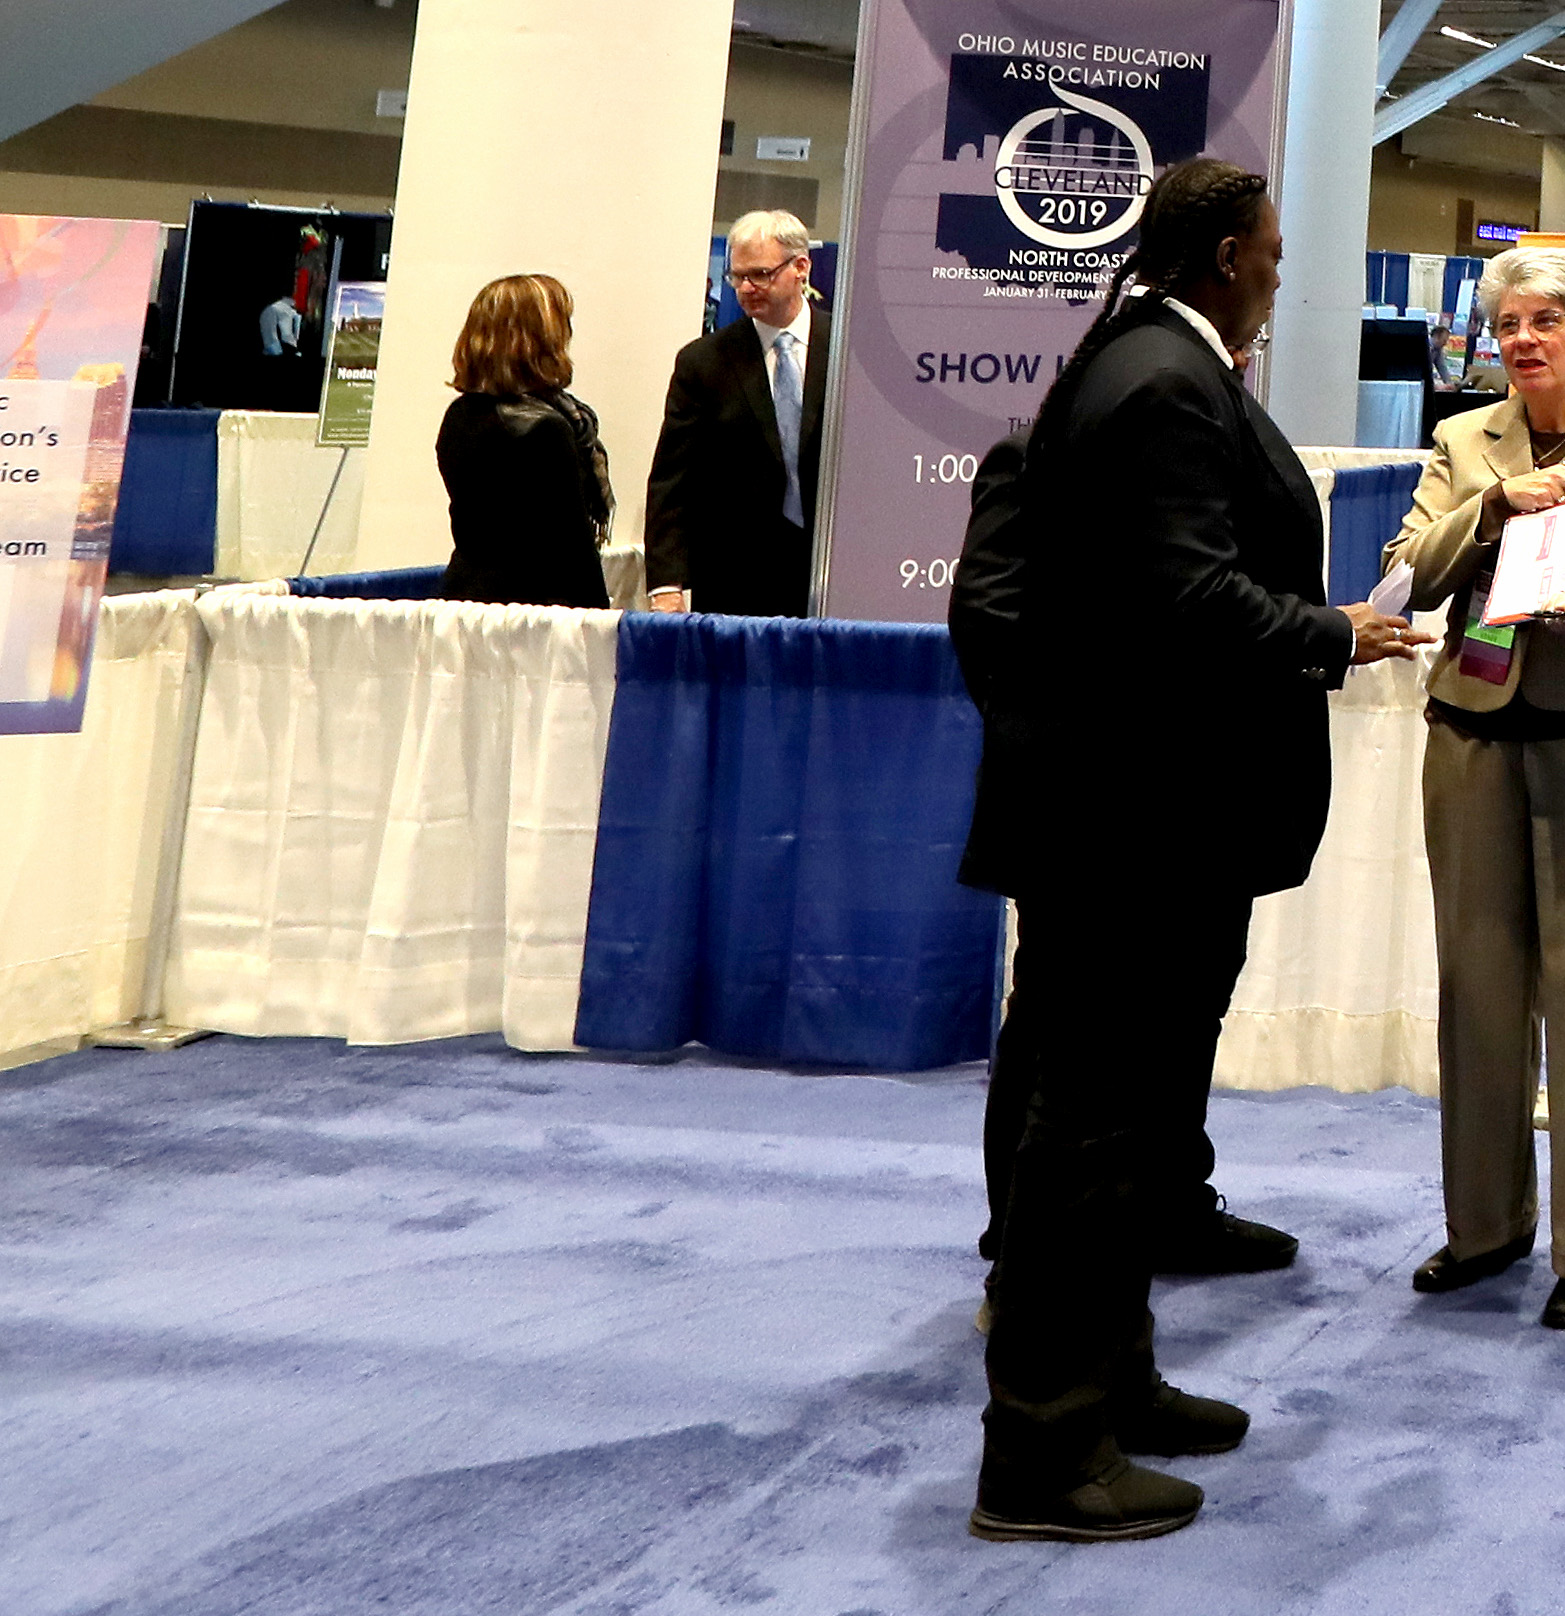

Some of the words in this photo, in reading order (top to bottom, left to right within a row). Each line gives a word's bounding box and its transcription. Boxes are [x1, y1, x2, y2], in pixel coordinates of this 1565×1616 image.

[958, 33, 1015, 54] OHIO
[1022, 39, 1086, 60] MUSIC
[1092, 45, 1205, 70] EDUCATION
[1003, 62, 1160, 90] ASSOCIATION
[994, 167, 1154, 196] CLEVELAND
[1038, 198, 1107, 226] 2019
[1009, 249, 1068, 267] NORTH
[1073, 251, 1129, 269] COAST
[932, 267, 1025, 283] PROFESSIONAL
[1028, 270, 1115, 284] DEVELOPMENT
[983, 286, 1034, 298] JANUARY
[916, 352, 1042, 384] SHOW
[913, 454, 978, 483] 1:00
